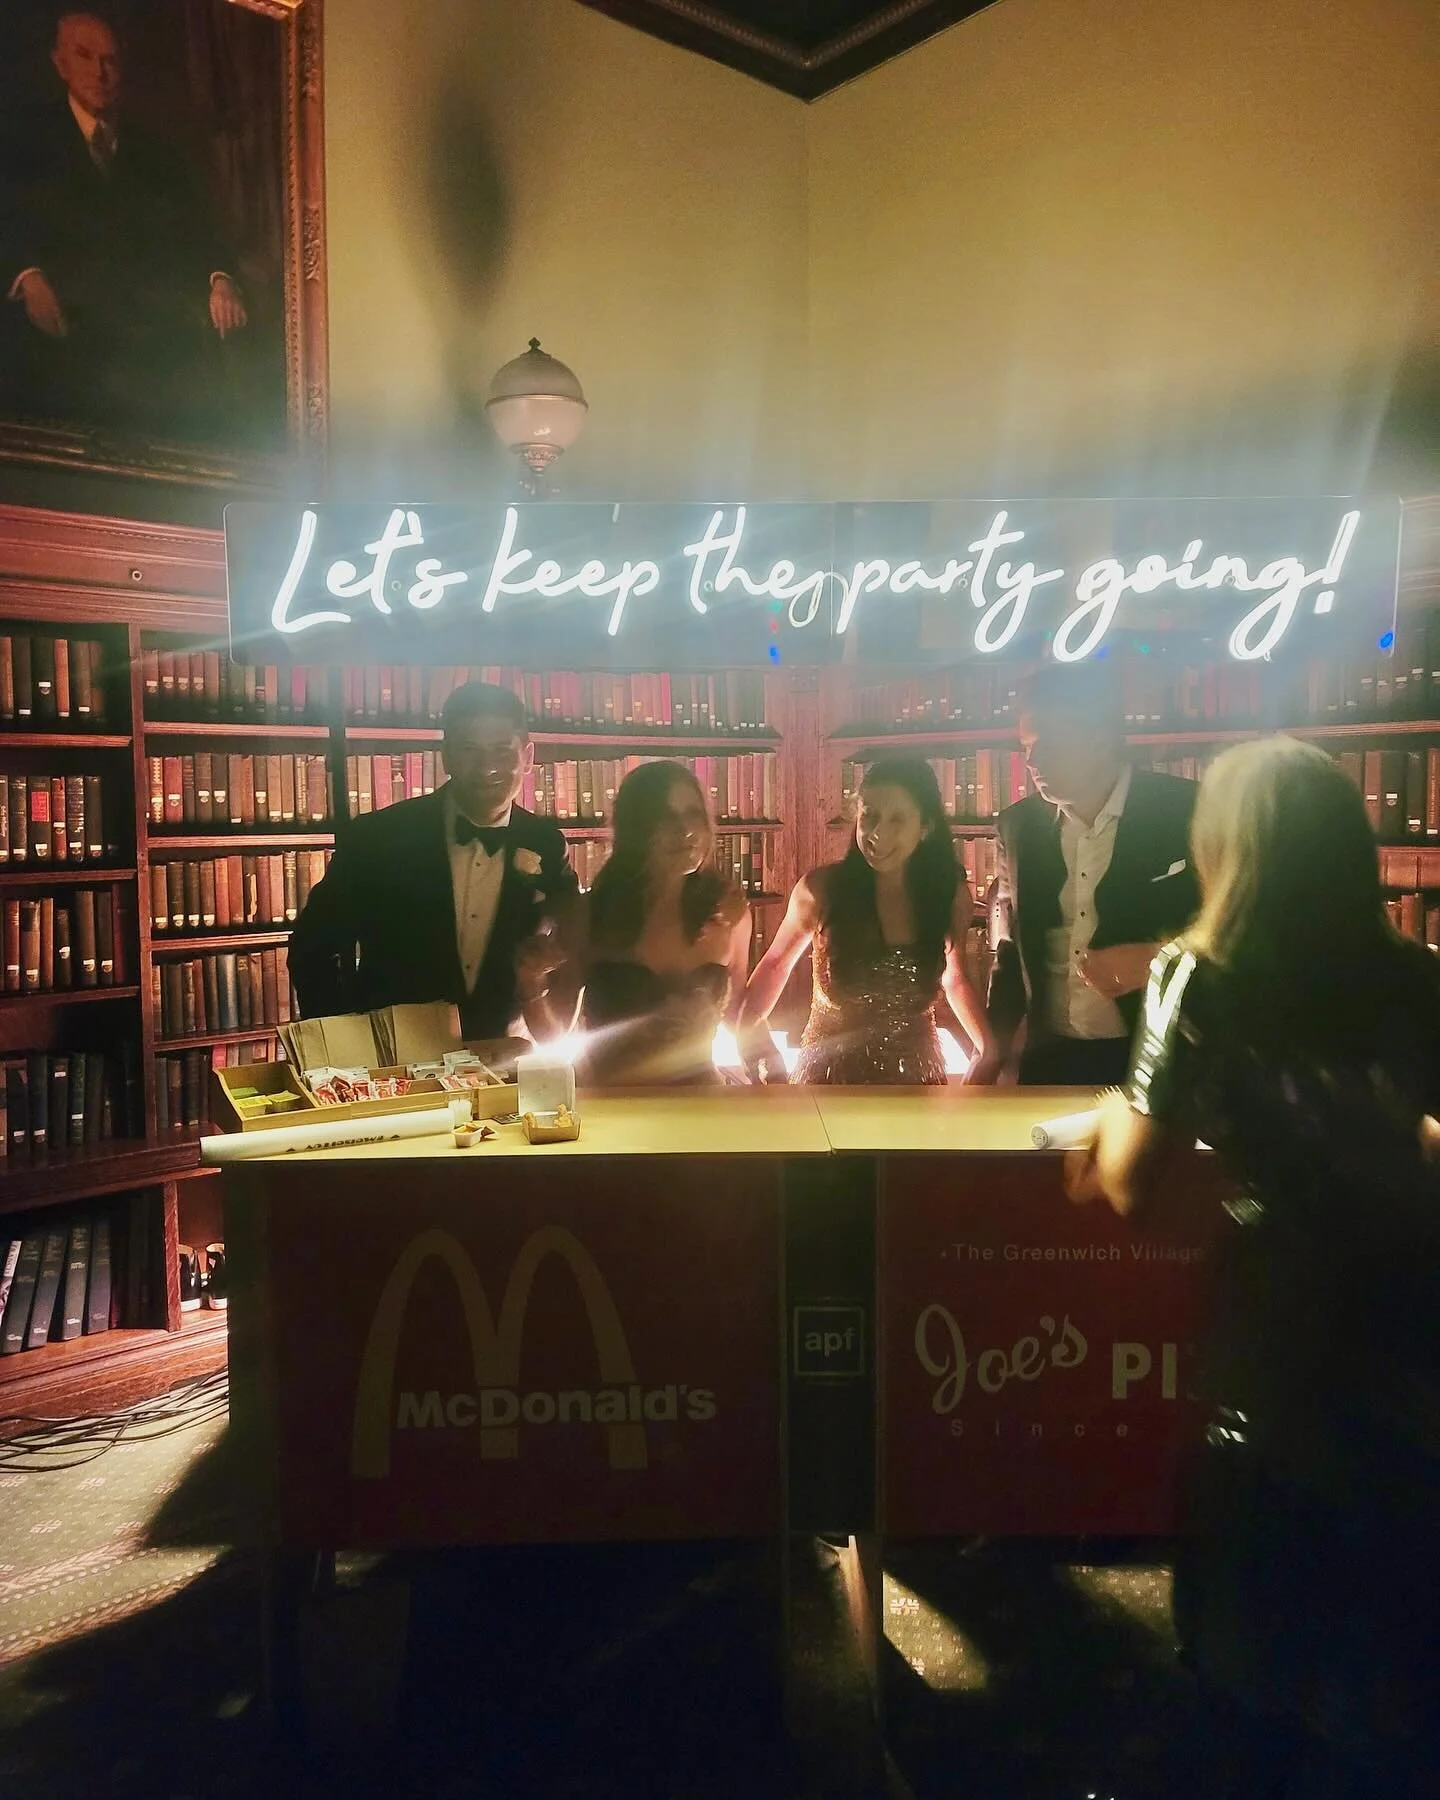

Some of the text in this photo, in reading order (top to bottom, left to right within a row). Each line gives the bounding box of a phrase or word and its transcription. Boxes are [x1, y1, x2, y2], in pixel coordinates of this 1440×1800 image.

[271, 508, 468, 634] Let's
[482, 506, 661, 636] keep
[836, 510, 1064, 653] party
[1052, 510, 1362, 663] going!
[952, 1242, 994, 1262] The
[1003, 1242, 1121, 1262] Greenwich
[804, 1326, 856, 1357] apf
[914, 1303, 1089, 1415] Joe's
[396, 1384, 717, 1428] McDonald's
